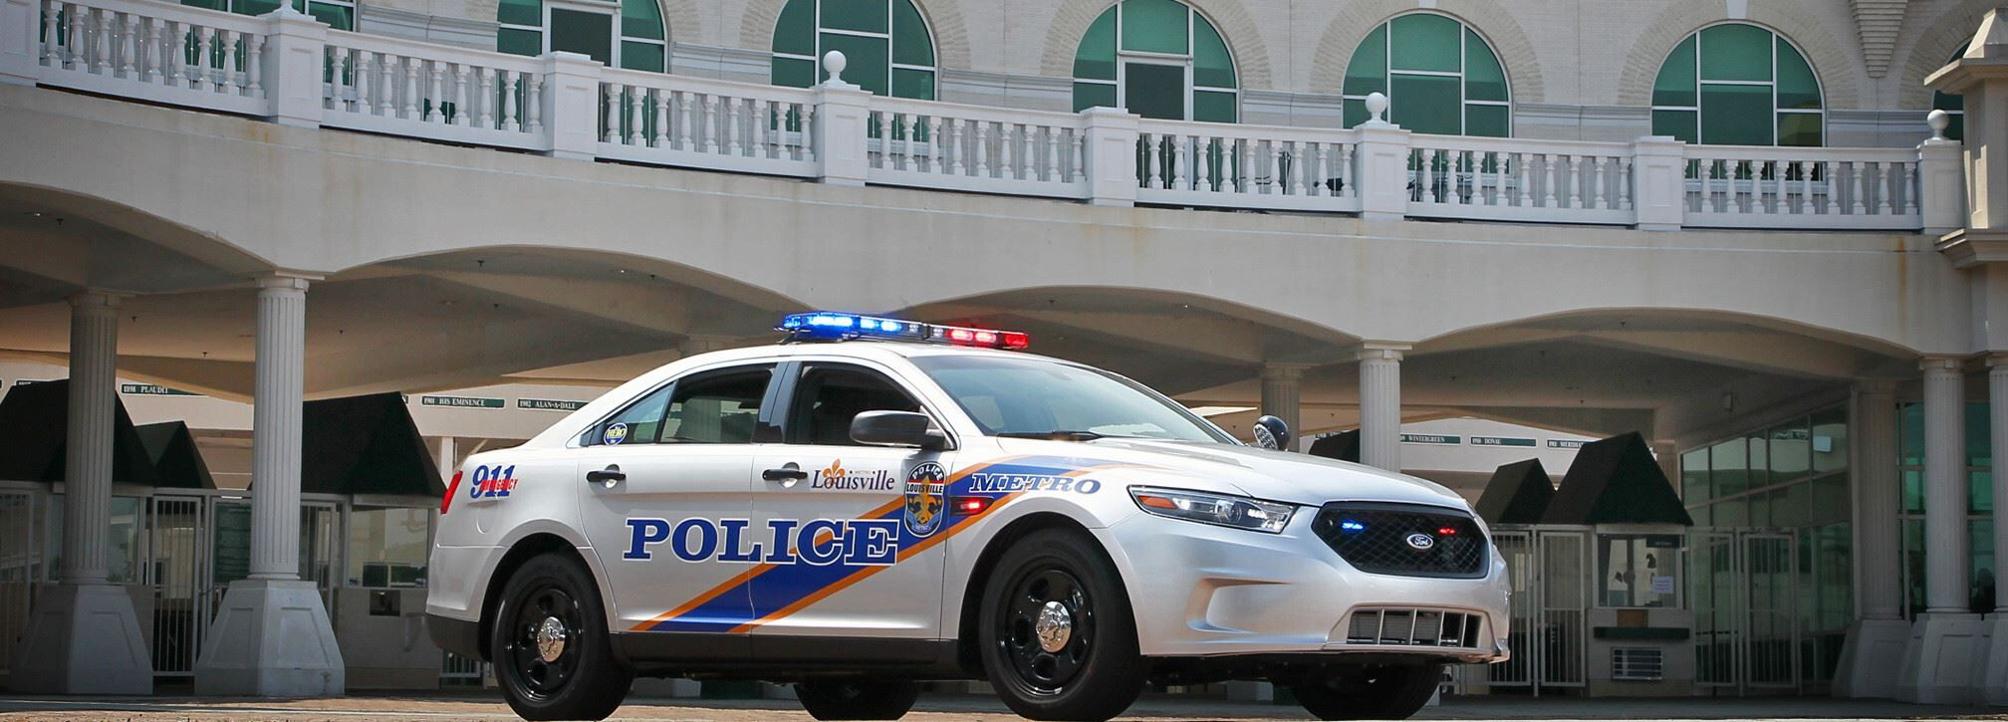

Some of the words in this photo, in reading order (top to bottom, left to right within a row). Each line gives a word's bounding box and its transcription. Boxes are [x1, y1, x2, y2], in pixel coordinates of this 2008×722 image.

[452, 398, 486, 407] EMINENCE
[470, 465, 516, 499] 911
[811, 469, 895, 491] Louisville
[911, 464, 944, 481] POLICE
[969, 472, 1102, 495] METRO
[906, 483, 944, 494] LOUISVILLE
[622, 517, 900, 566] POLICE
